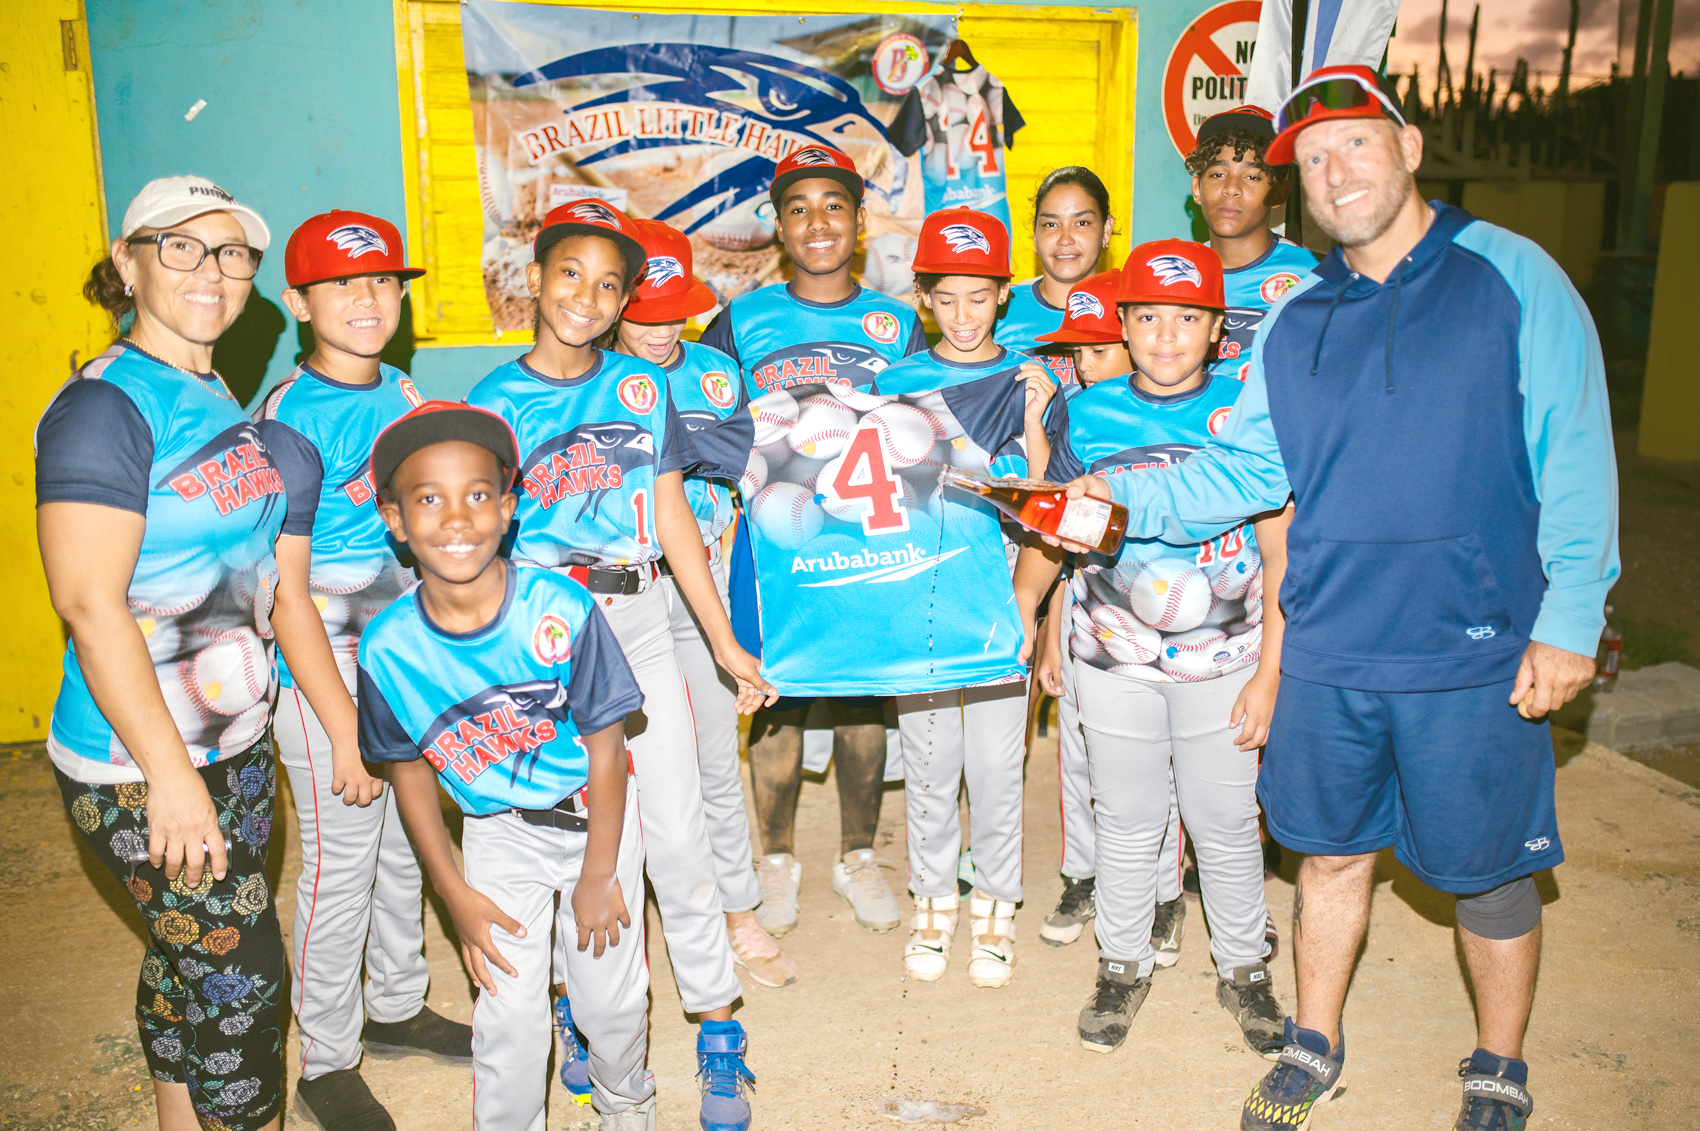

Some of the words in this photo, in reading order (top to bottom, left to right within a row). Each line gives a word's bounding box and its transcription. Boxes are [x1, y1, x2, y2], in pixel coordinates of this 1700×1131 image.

[1191, 76, 1248, 100] POLIT
[520, 107, 631, 162] BRAZIL
[638, 107, 740, 146] LITTLE
[942, 184, 997, 204] babank
[753, 356, 837, 390] BRAZIL
[168, 443, 269, 502] BRAZIL
[210, 467, 284, 516] HAWKS
[520, 440, 606, 501] BRAZIL
[540, 464, 623, 511] HAWKS
[831, 424, 909, 536] 4
[630, 488, 652, 547] 1
[791, 542, 923, 573] Arubabank
[422, 703, 531, 773] BRAZIL
[450, 719, 558, 785] HAWKS
[1281, 1046, 1331, 1078] OMBAH
[1463, 1079, 1529, 1107] BOOMBAH
